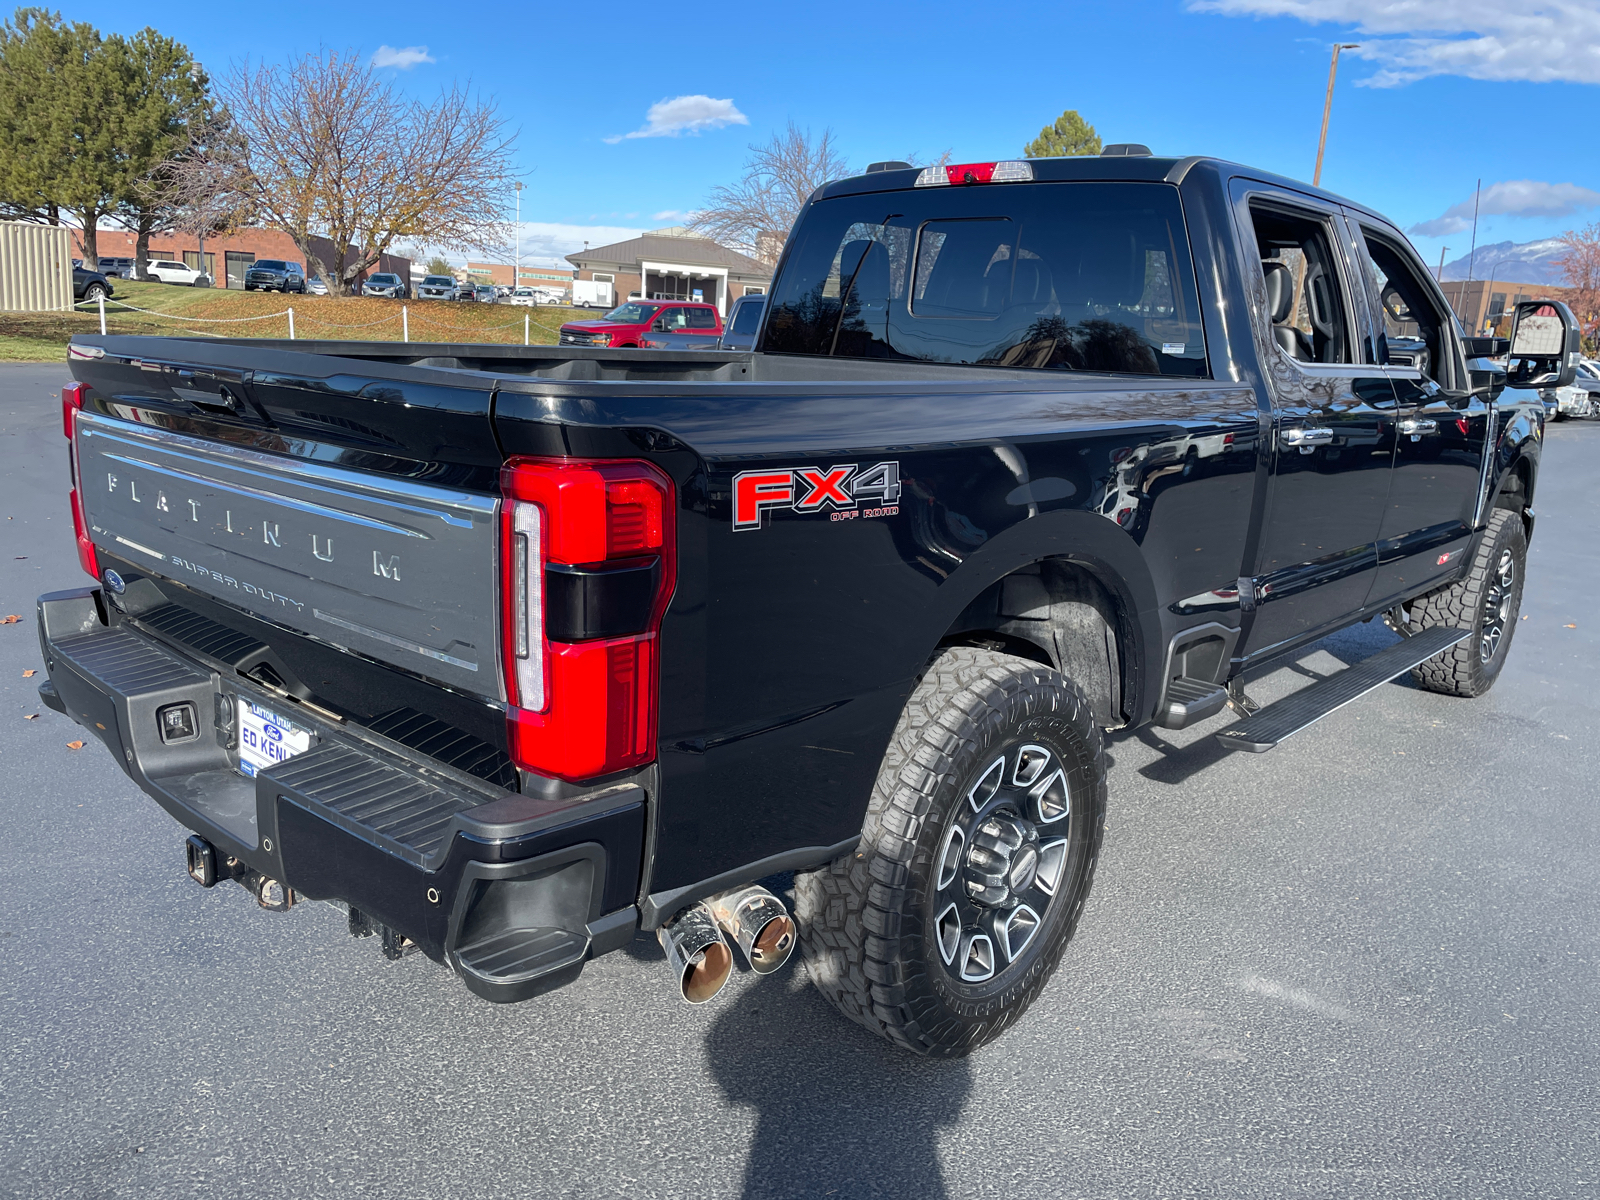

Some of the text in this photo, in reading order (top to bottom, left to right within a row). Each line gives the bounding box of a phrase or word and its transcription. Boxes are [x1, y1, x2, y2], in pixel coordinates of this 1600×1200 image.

[732, 461, 902, 532] FX4
[830, 506, 900, 522] OFF ROAD
[107, 472, 401, 582] PLATINUM
[171, 555, 305, 612] SUPER DUTY
[265, 725, 281, 741] Ford
[276, 714, 292, 732] UTAH
[243, 727, 257, 748] ED
